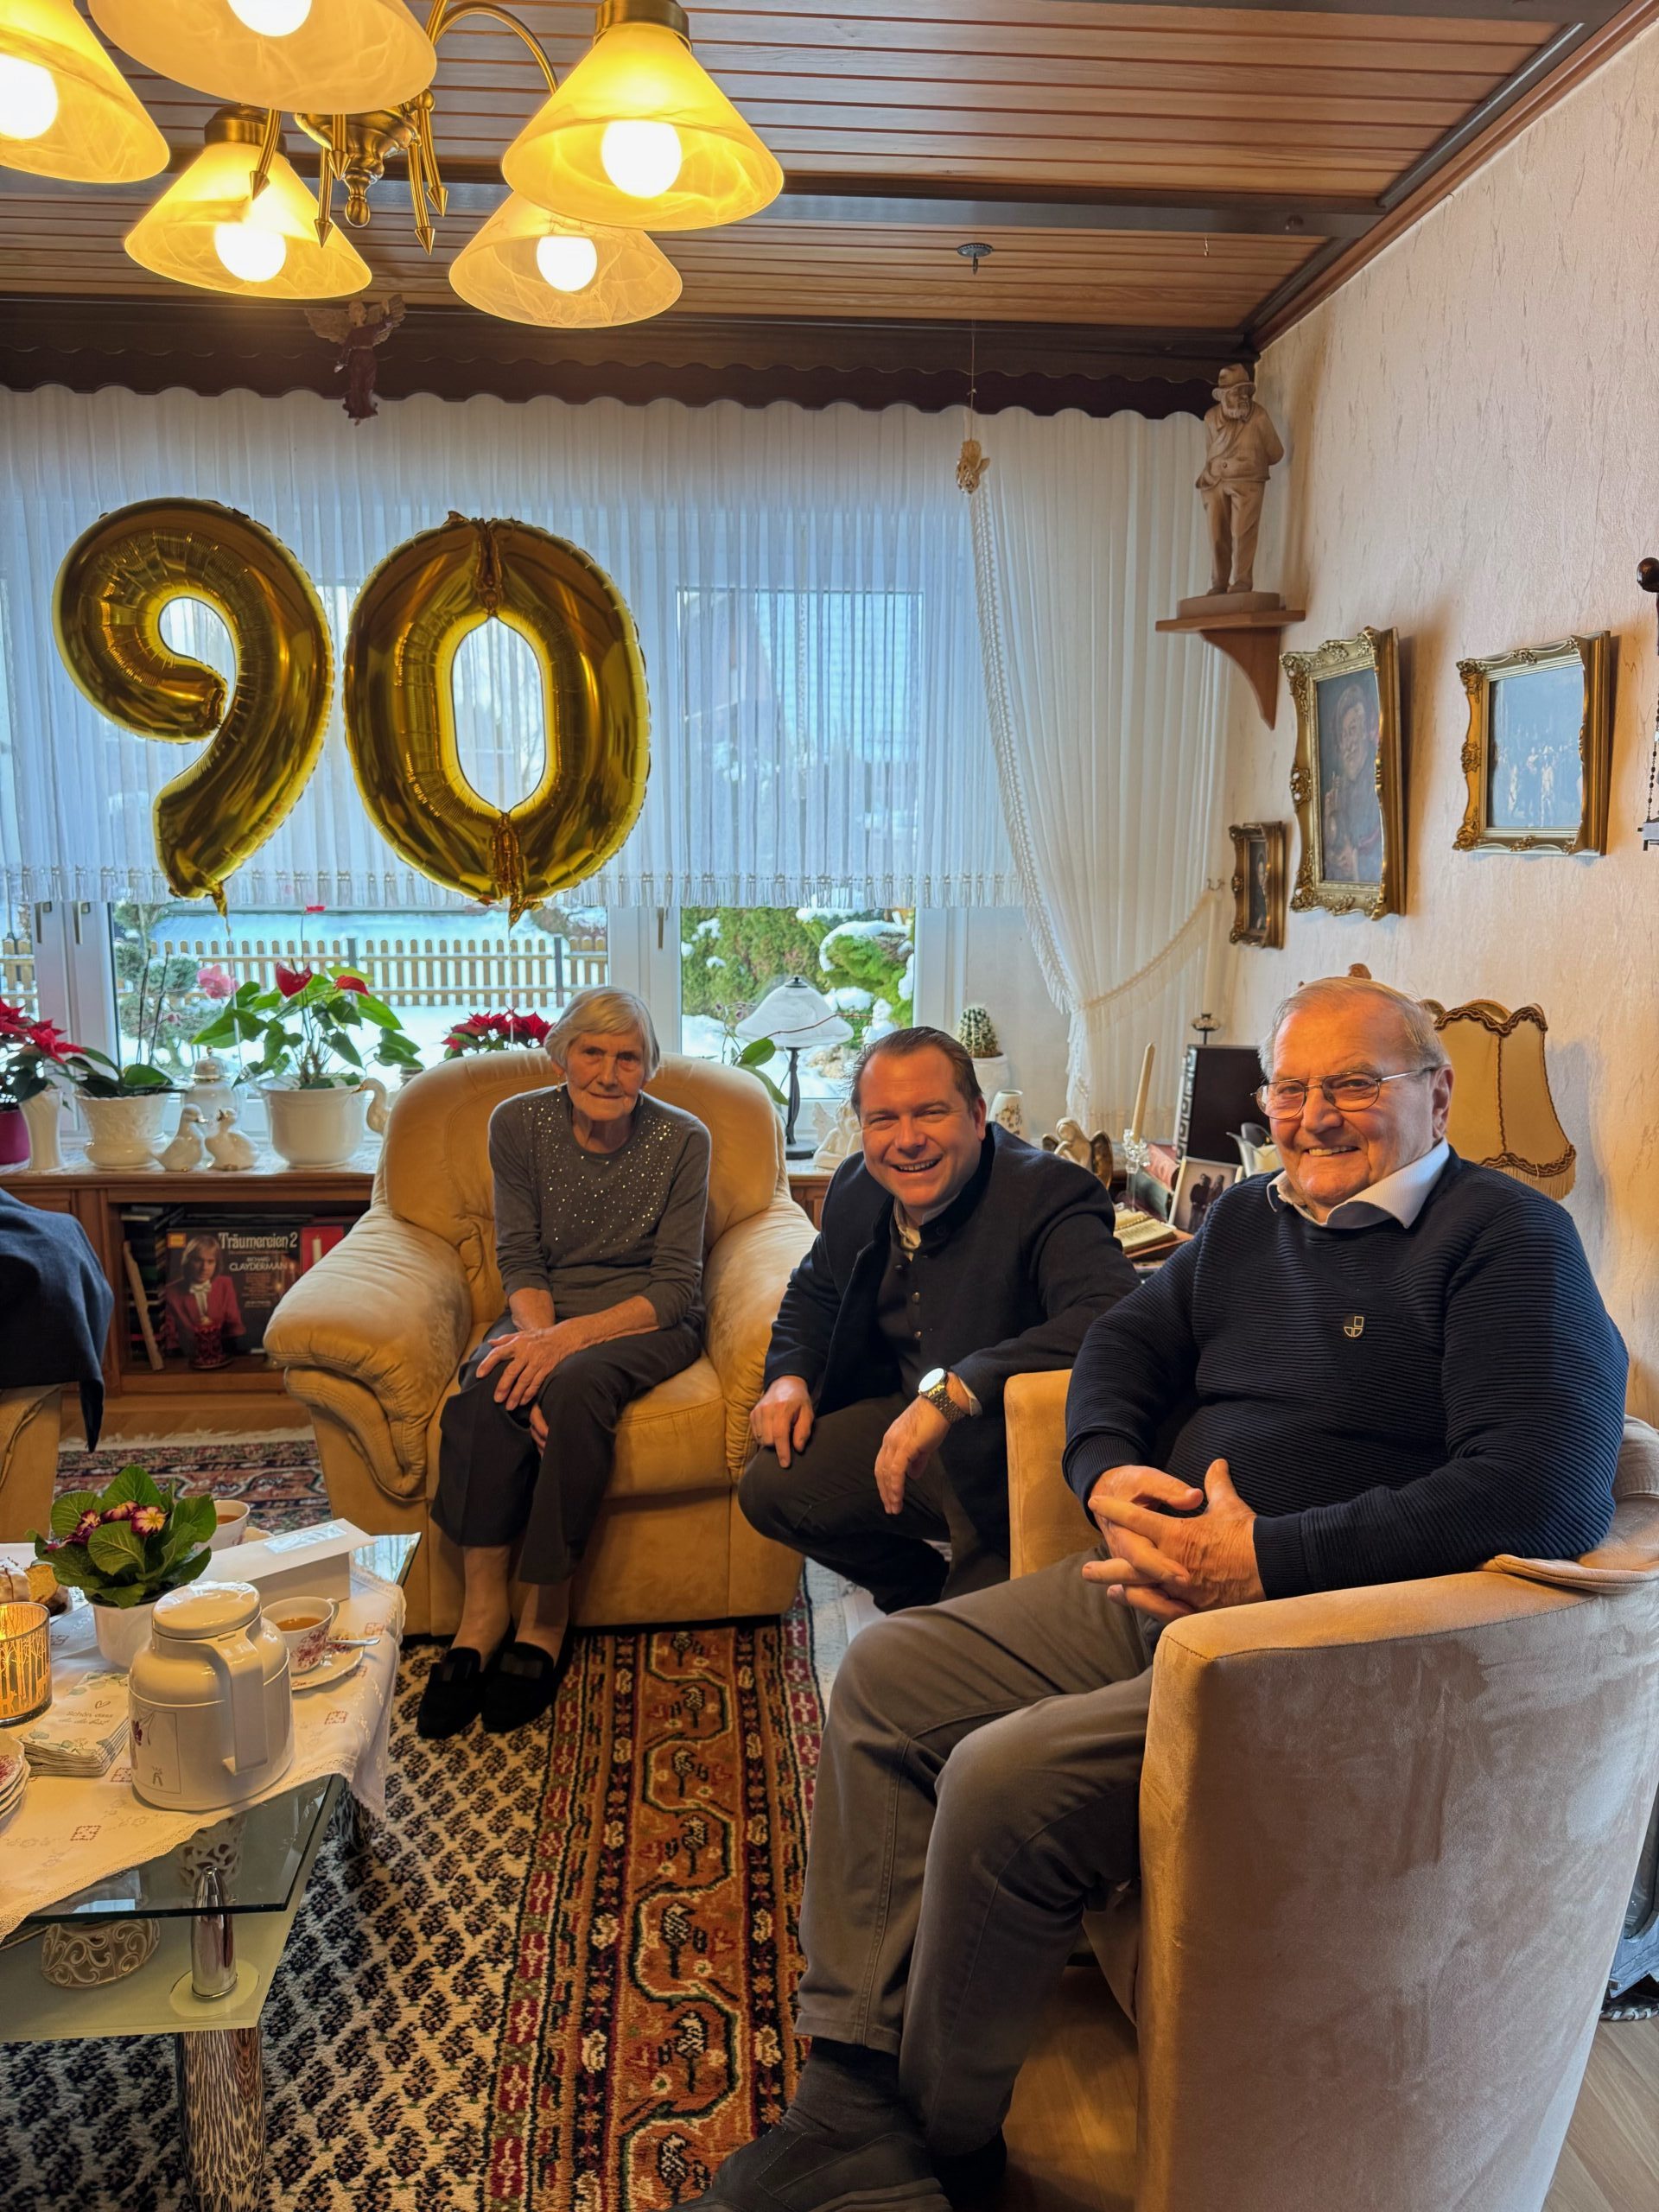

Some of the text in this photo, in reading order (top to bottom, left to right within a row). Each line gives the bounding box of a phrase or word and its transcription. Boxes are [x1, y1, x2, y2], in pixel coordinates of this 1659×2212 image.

[53, 496, 652, 918] 90
[218, 1231, 298, 1249] Träumereien 2
[229, 1262, 288, 1271] CLAYDERMAN
